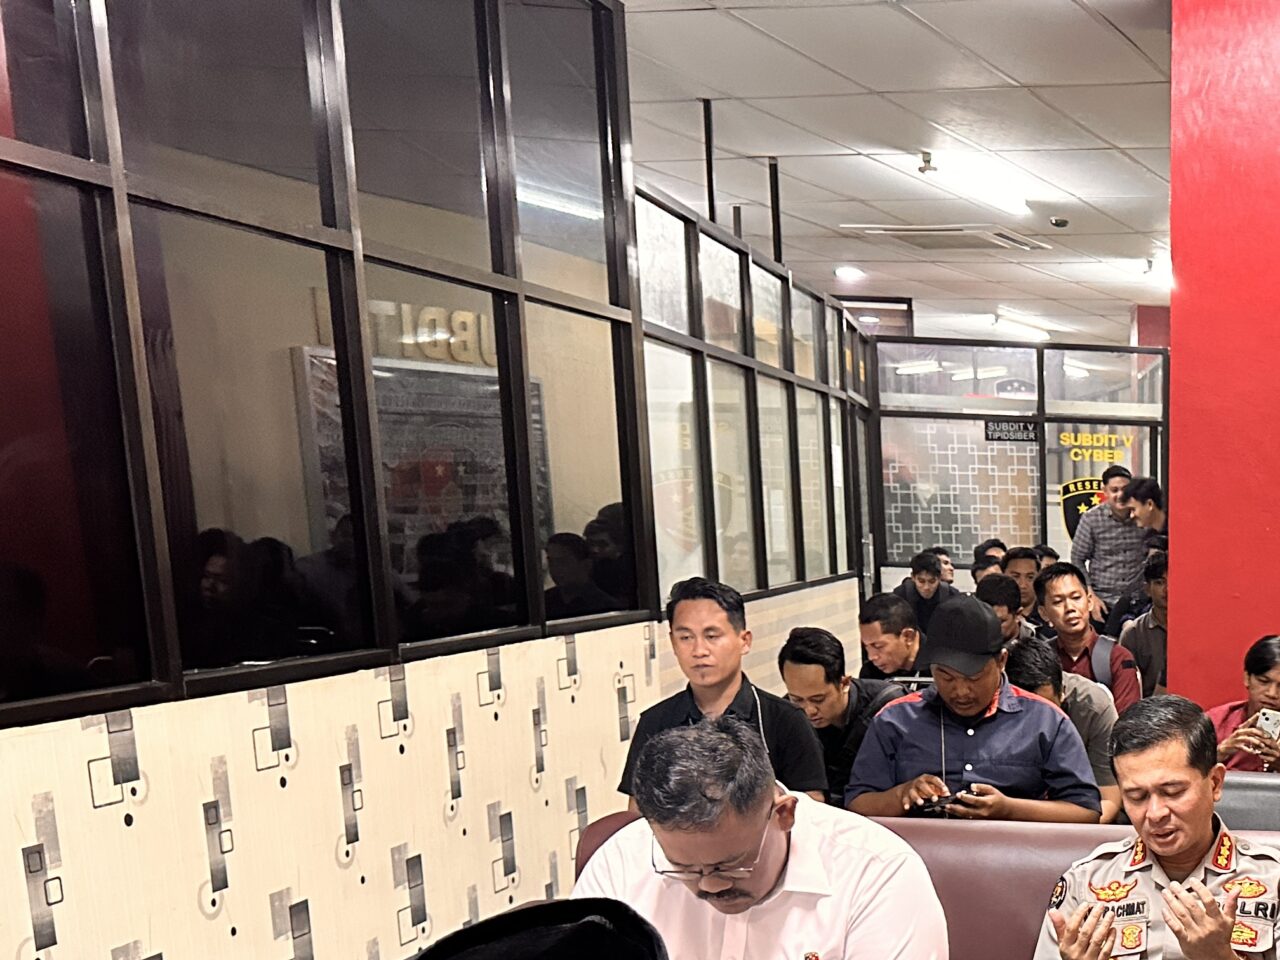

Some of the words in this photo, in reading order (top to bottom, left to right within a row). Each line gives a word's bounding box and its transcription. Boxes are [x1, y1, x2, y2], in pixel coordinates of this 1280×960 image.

[987, 421, 1024, 432] SUBDIT
[1027, 422, 1034, 431] V
[988, 430, 1036, 440] TIPIDSIBER
[1059, 432, 1118, 447] SUBDIT
[1122, 435, 1134, 447] V
[1070, 449, 1124, 462] CYBER
[1068, 480, 1099, 493] RESE
